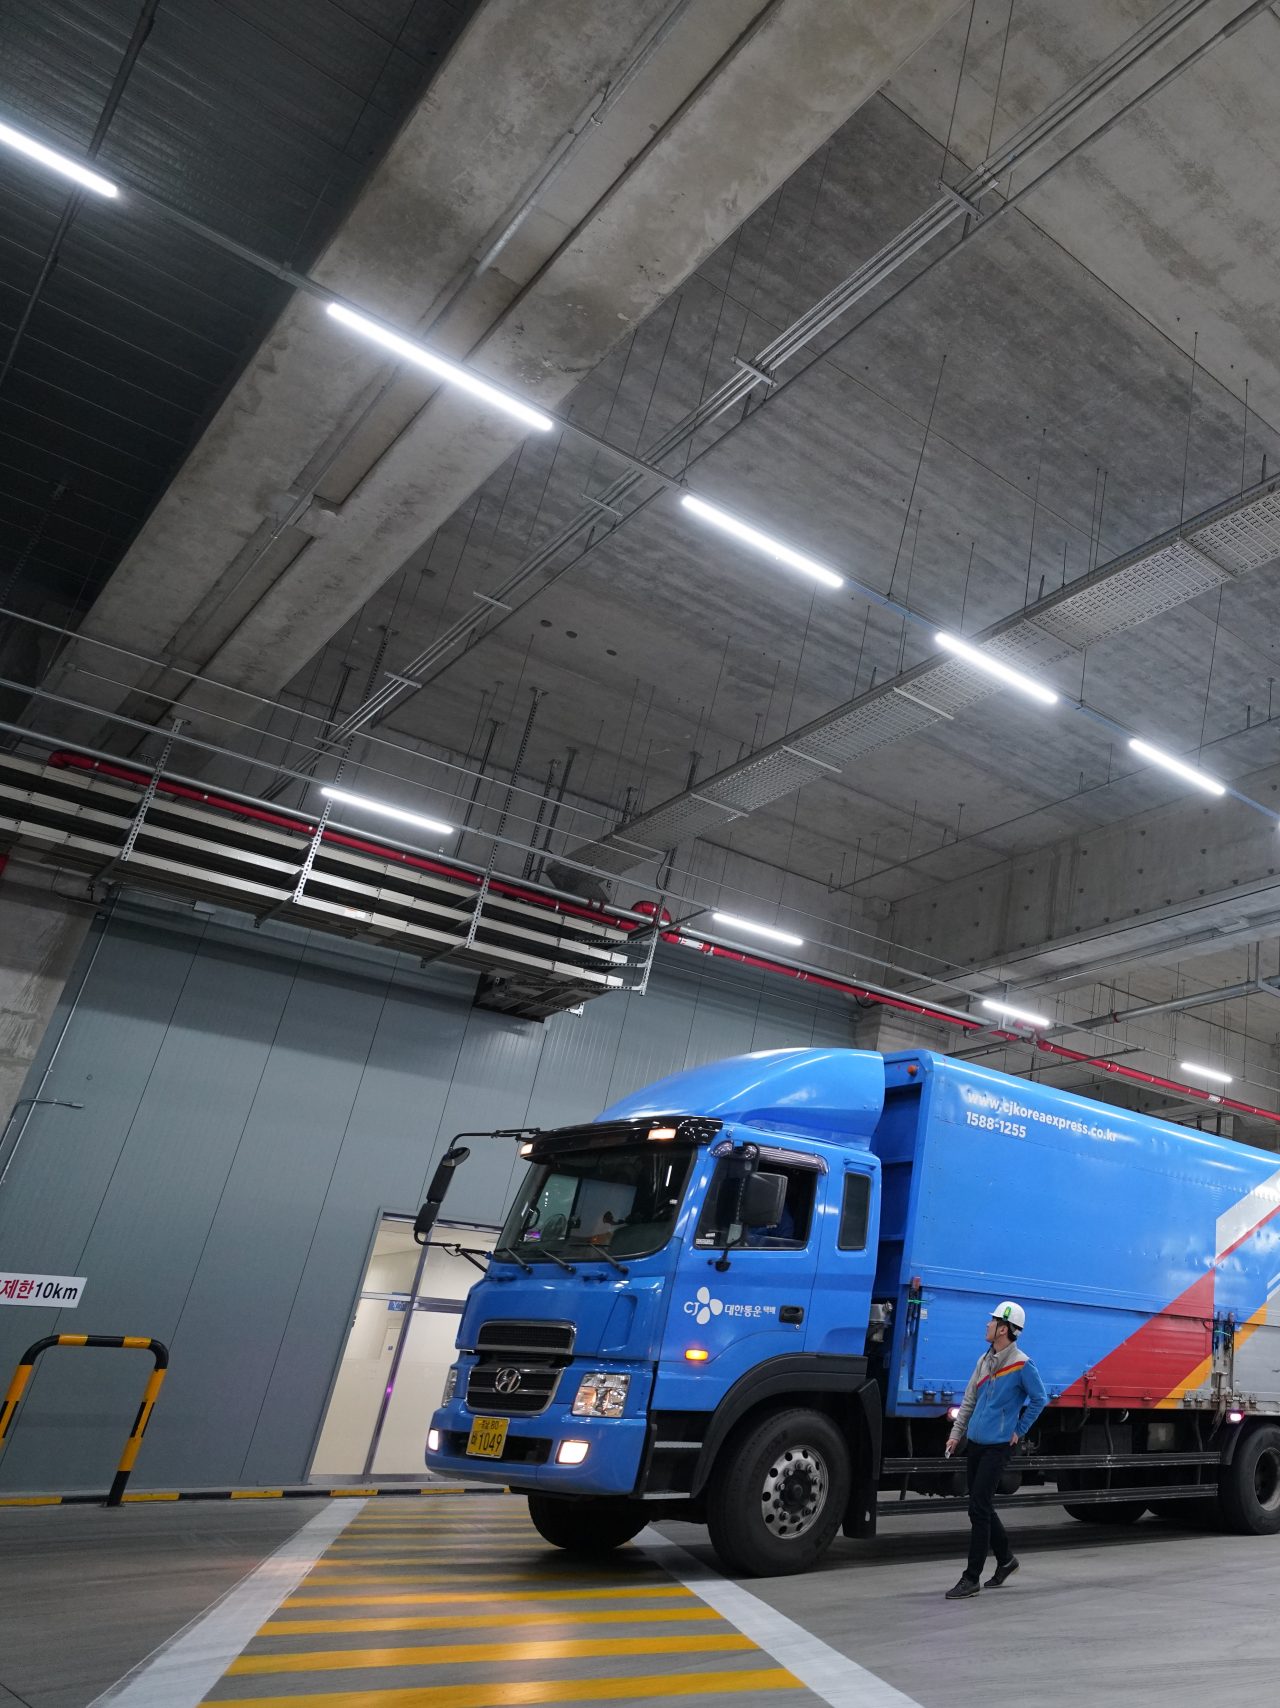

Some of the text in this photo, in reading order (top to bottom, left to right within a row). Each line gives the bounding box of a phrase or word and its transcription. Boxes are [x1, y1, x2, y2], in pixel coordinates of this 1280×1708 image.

[966, 1111, 1027, 1139] 1588-1255
[967, 1091, 1118, 1142] www.cjkoreaexpress.co.kr
[684, 1301, 700, 1316] CJ
[725, 1304, 761, 1318] 대한통운
[478, 1432, 503, 1453] 1049
